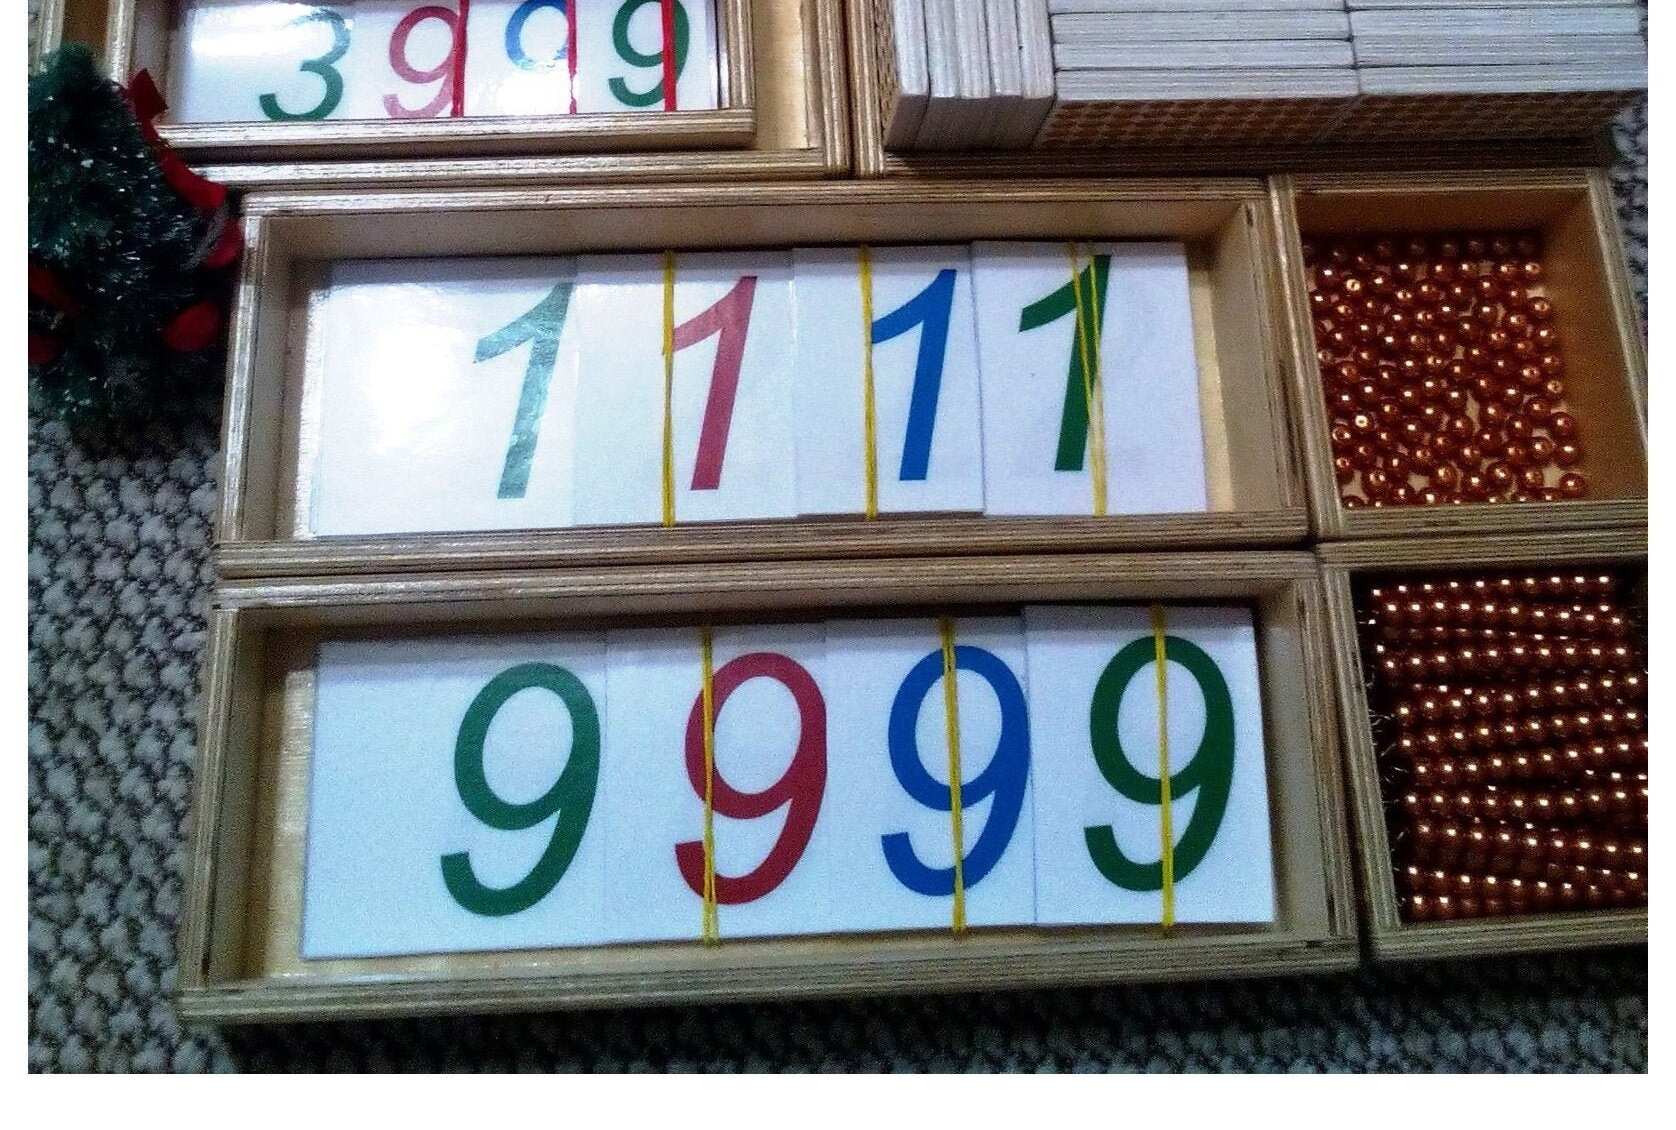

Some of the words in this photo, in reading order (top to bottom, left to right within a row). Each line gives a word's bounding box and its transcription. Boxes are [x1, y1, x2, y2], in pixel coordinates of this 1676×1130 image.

[259, 6, 351, 121] 3
[383, 6, 467, 119] 9
[473, 281, 573, 500] 1
[662, 276, 757, 491] 1
[871, 269, 957, 481] 1
[1019, 254, 1112, 472] 1
[440, 662, 601, 917] 9
[674, 652, 828, 906] 9
[881, 645, 1030, 897] 9
[1083, 635, 1236, 891] 9
